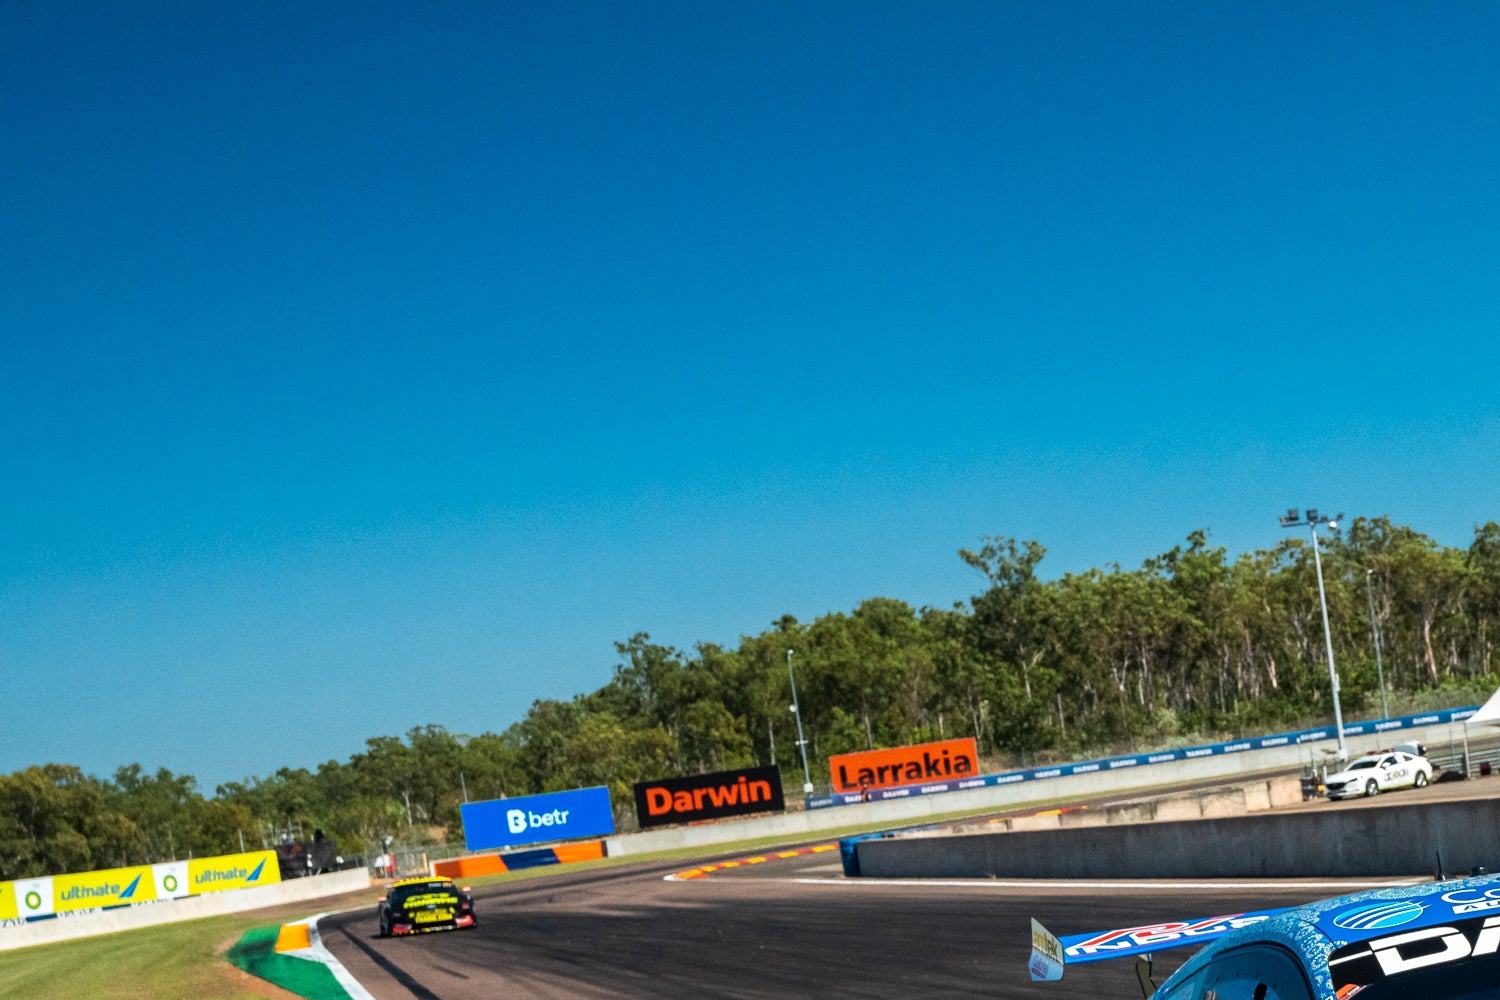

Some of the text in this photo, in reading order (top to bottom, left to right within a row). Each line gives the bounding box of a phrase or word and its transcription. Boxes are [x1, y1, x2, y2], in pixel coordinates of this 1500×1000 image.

[839, 750, 971, 789] Larrakia
[645, 776, 771, 816] Darwin
[529, 809, 569, 828] betr
[195, 867, 247, 884] ultimate
[61, 883, 120, 901] ultimate
